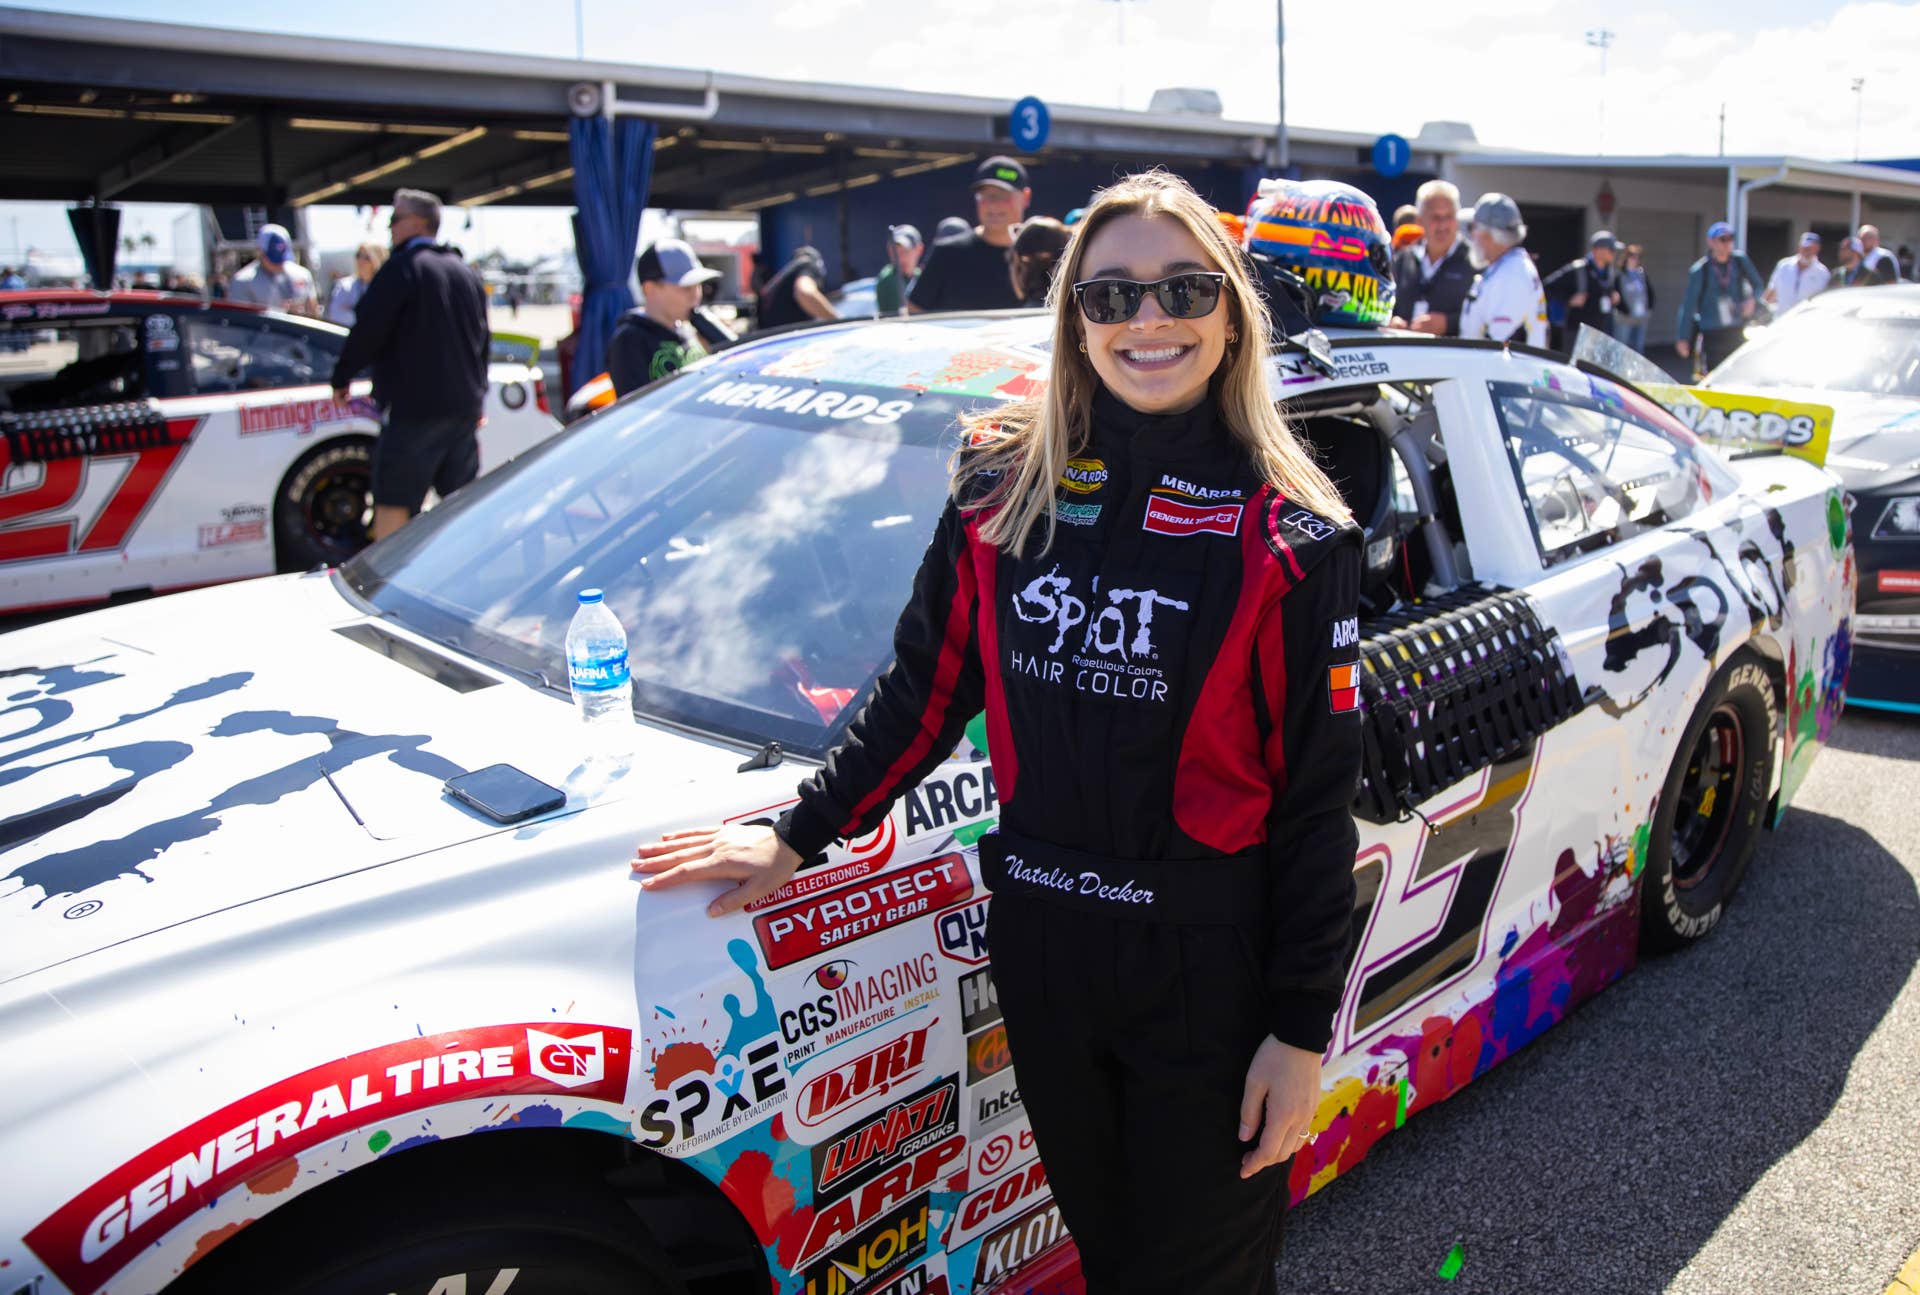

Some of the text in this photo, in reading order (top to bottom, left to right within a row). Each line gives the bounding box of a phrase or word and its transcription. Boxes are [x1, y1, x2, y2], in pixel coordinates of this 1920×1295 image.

[1021, 105, 1040, 140] 3
[1387, 140, 1397, 166] 1
[1332, 352, 1376, 364] ATALIE
[696, 381, 914, 425] MENARDS
[1671, 404, 1816, 446] NARDS
[1064, 467, 1108, 483] NARDS
[1161, 475, 1242, 499] MENARDS
[1149, 510, 1194, 525] GENERAL
[1012, 650, 1168, 702] HAIR COLOR
[1127, 664, 1163, 678] Colors
[902, 766, 999, 837] ARCA
[795, 862, 871, 895] ELECTRONICS
[1005, 854, 1154, 904] Natalie Decker
[767, 862, 955, 943] PYROTECT
[820, 897, 929, 946] SAFETY GEAR
[787, 988, 941, 1063] PRINT MANUFACTURE INSTALL
[732, 1114, 743, 1127] BY
[744, 1091, 788, 1121] EVALUATION
[81, 1075, 383, 1263] GENERAL
[386, 1045, 515, 1097] TIRE
[821, 1087, 948, 1186] LUNATI
[902, 1122, 956, 1157] CRANKS
[800, 1135, 967, 1262] ARP
[983, 1205, 1072, 1284] KLOT
